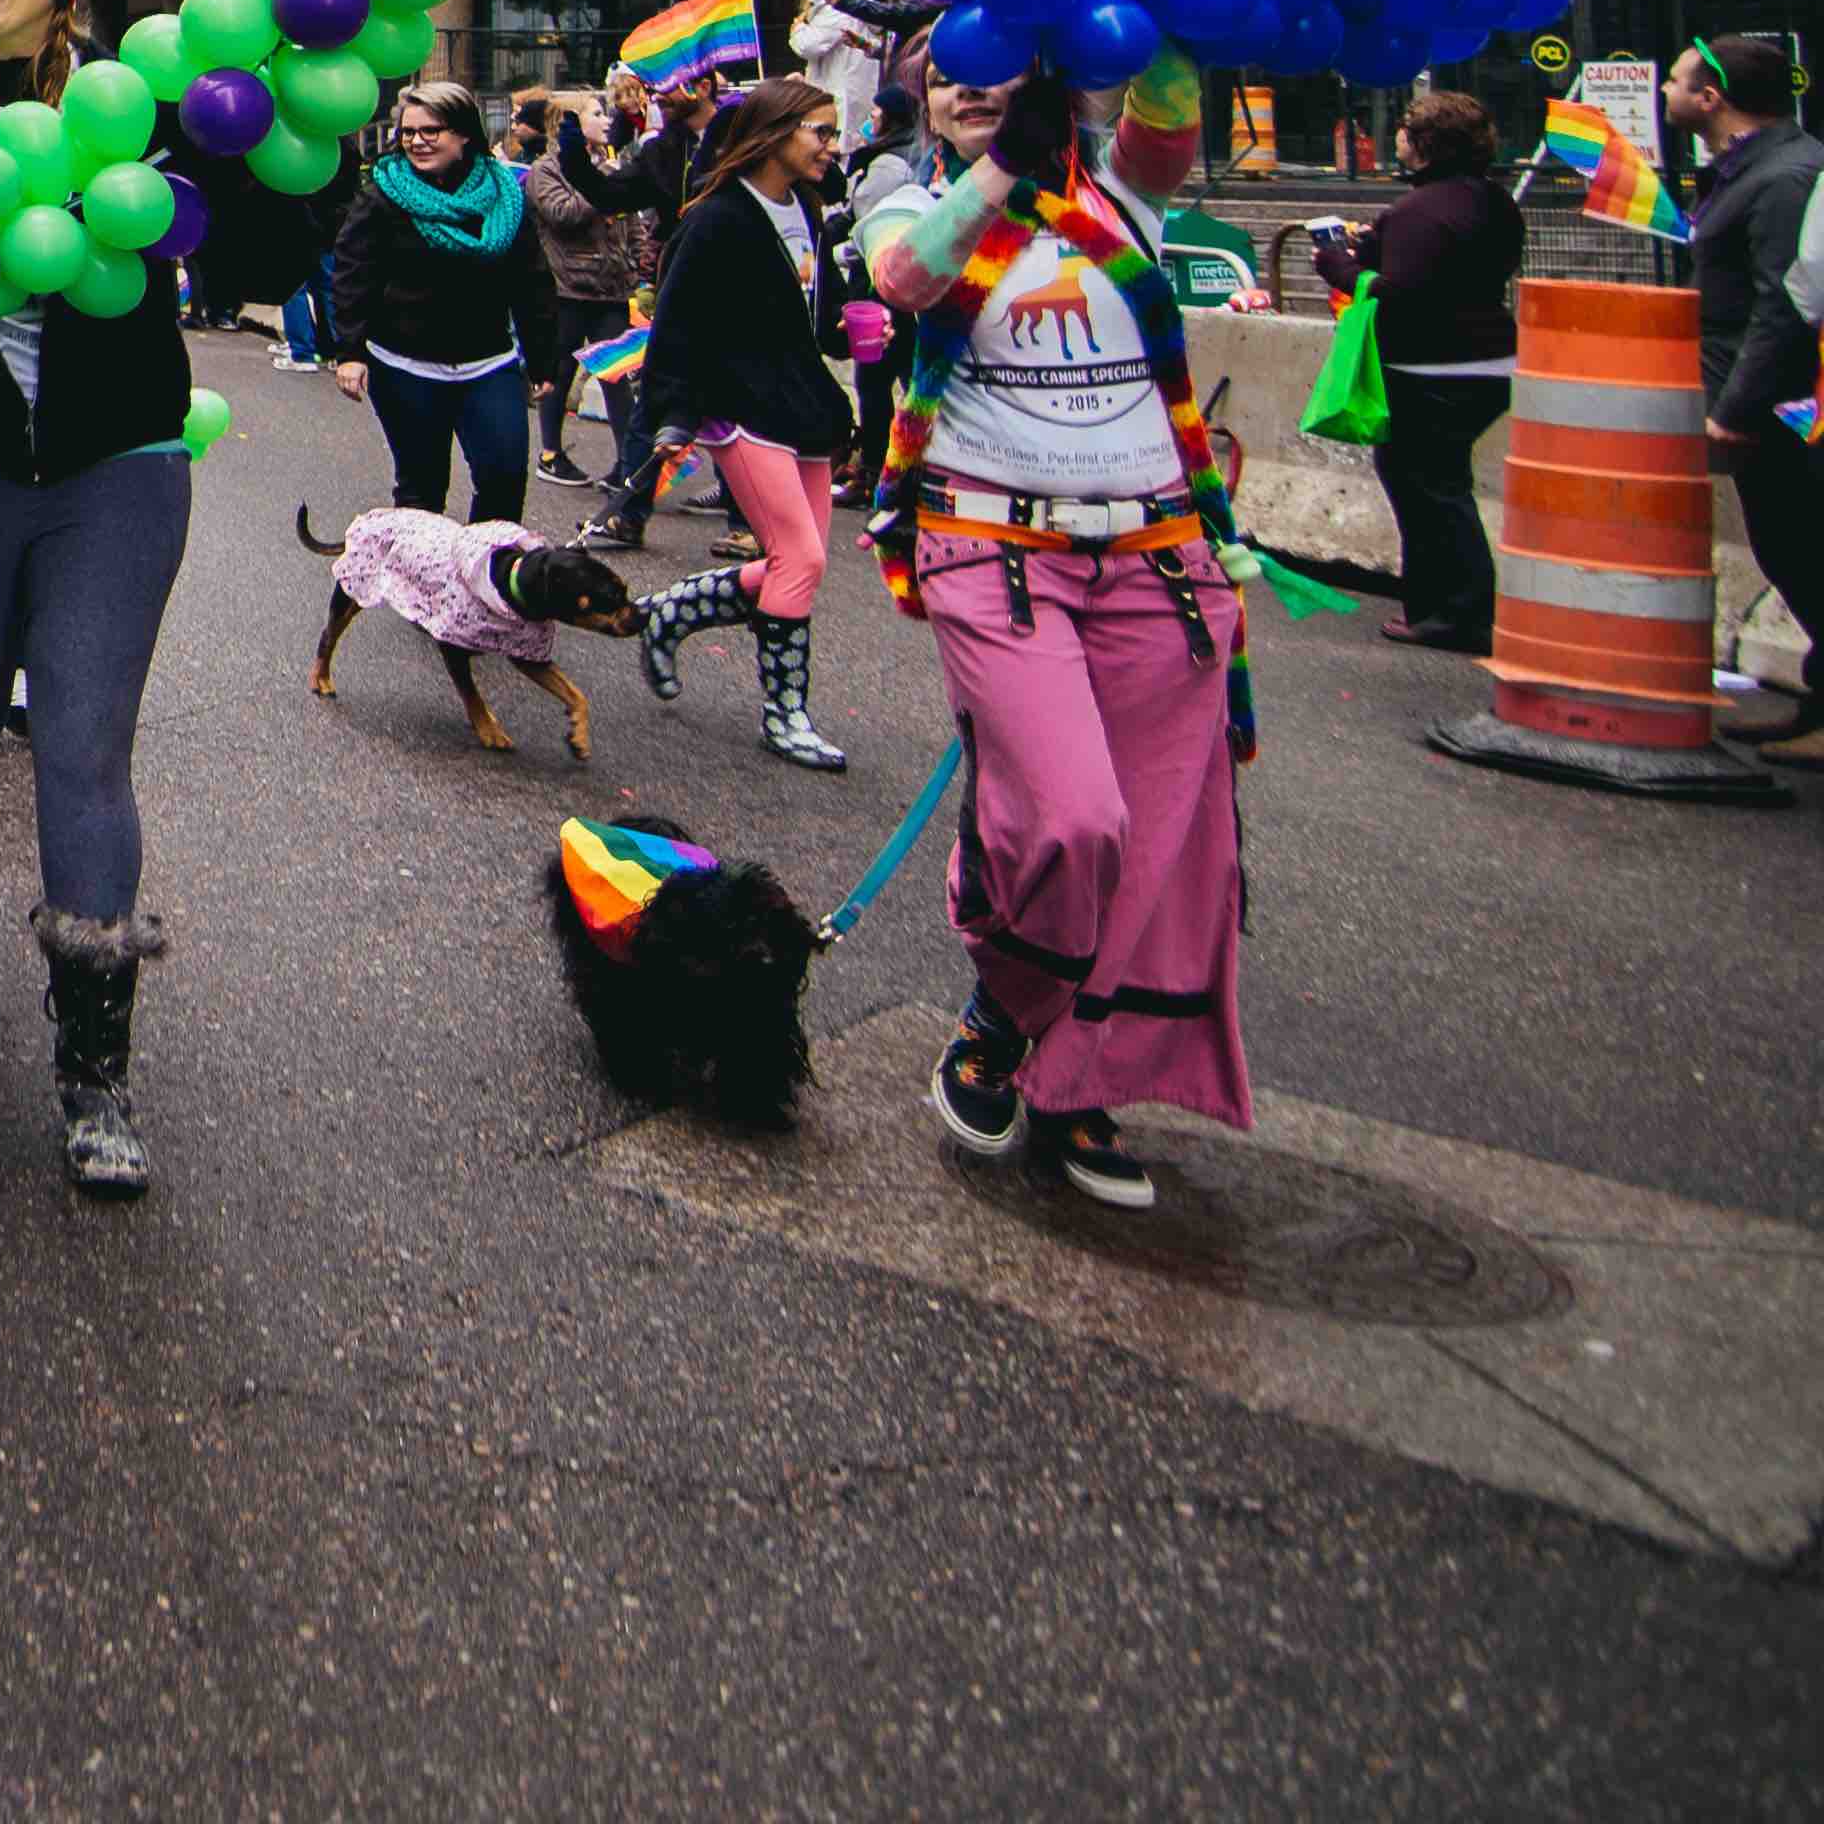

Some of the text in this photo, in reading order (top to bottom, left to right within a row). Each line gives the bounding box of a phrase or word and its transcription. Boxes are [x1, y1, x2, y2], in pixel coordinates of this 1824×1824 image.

[1538, 46, 1563, 61] PCL
[1585, 64, 1649, 81] CAUTION
[1040, 369, 1089, 385] CANINE
[1092, 362, 1151, 382] SPECIALIS
[1066, 395, 1100, 411] 2015
